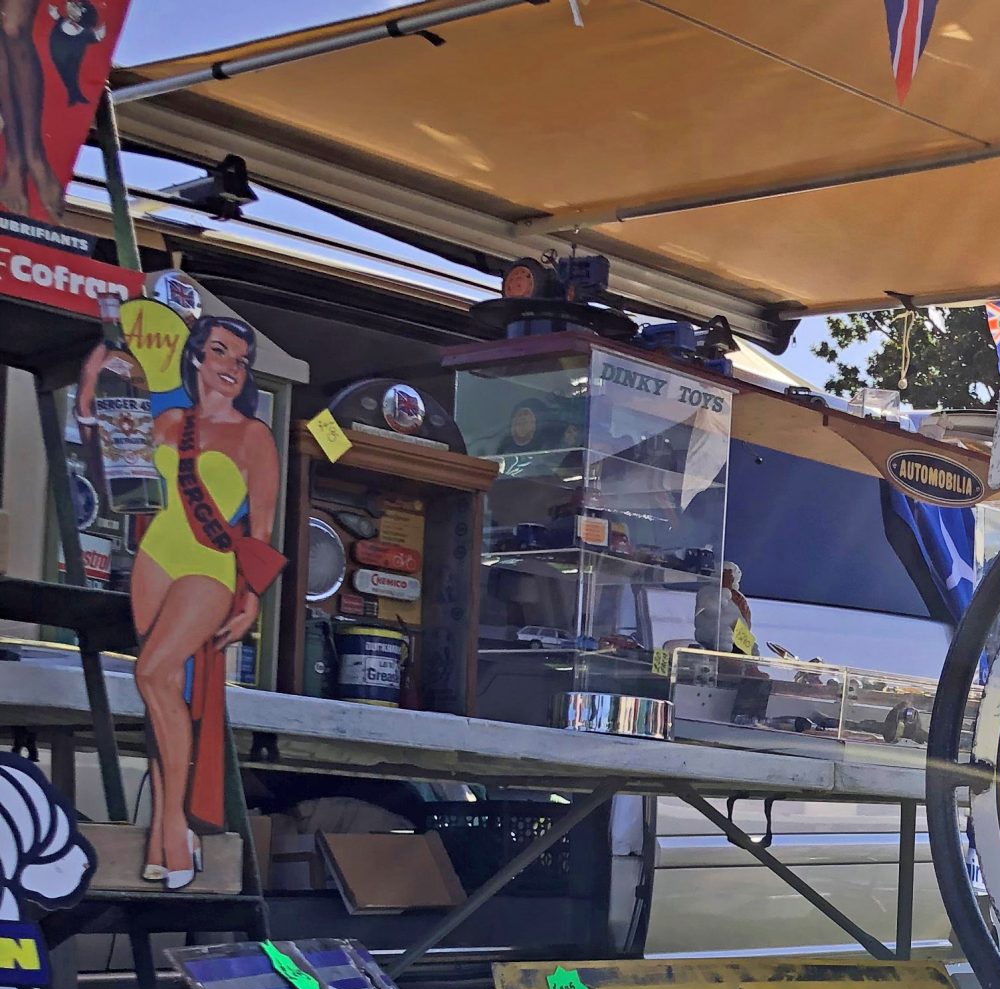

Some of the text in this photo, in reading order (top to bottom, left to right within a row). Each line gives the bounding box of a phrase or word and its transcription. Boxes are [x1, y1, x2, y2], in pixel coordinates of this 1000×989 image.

[10, 255, 129, 300] Cofran
[124, 307, 181, 373] Any
[600, 362, 725, 413] DINKY TOYS
[898, 459, 973, 496] AUTOMOBILIA
[177, 457, 233, 550] BERGER
[371, 573, 408, 589] CHEMICO
